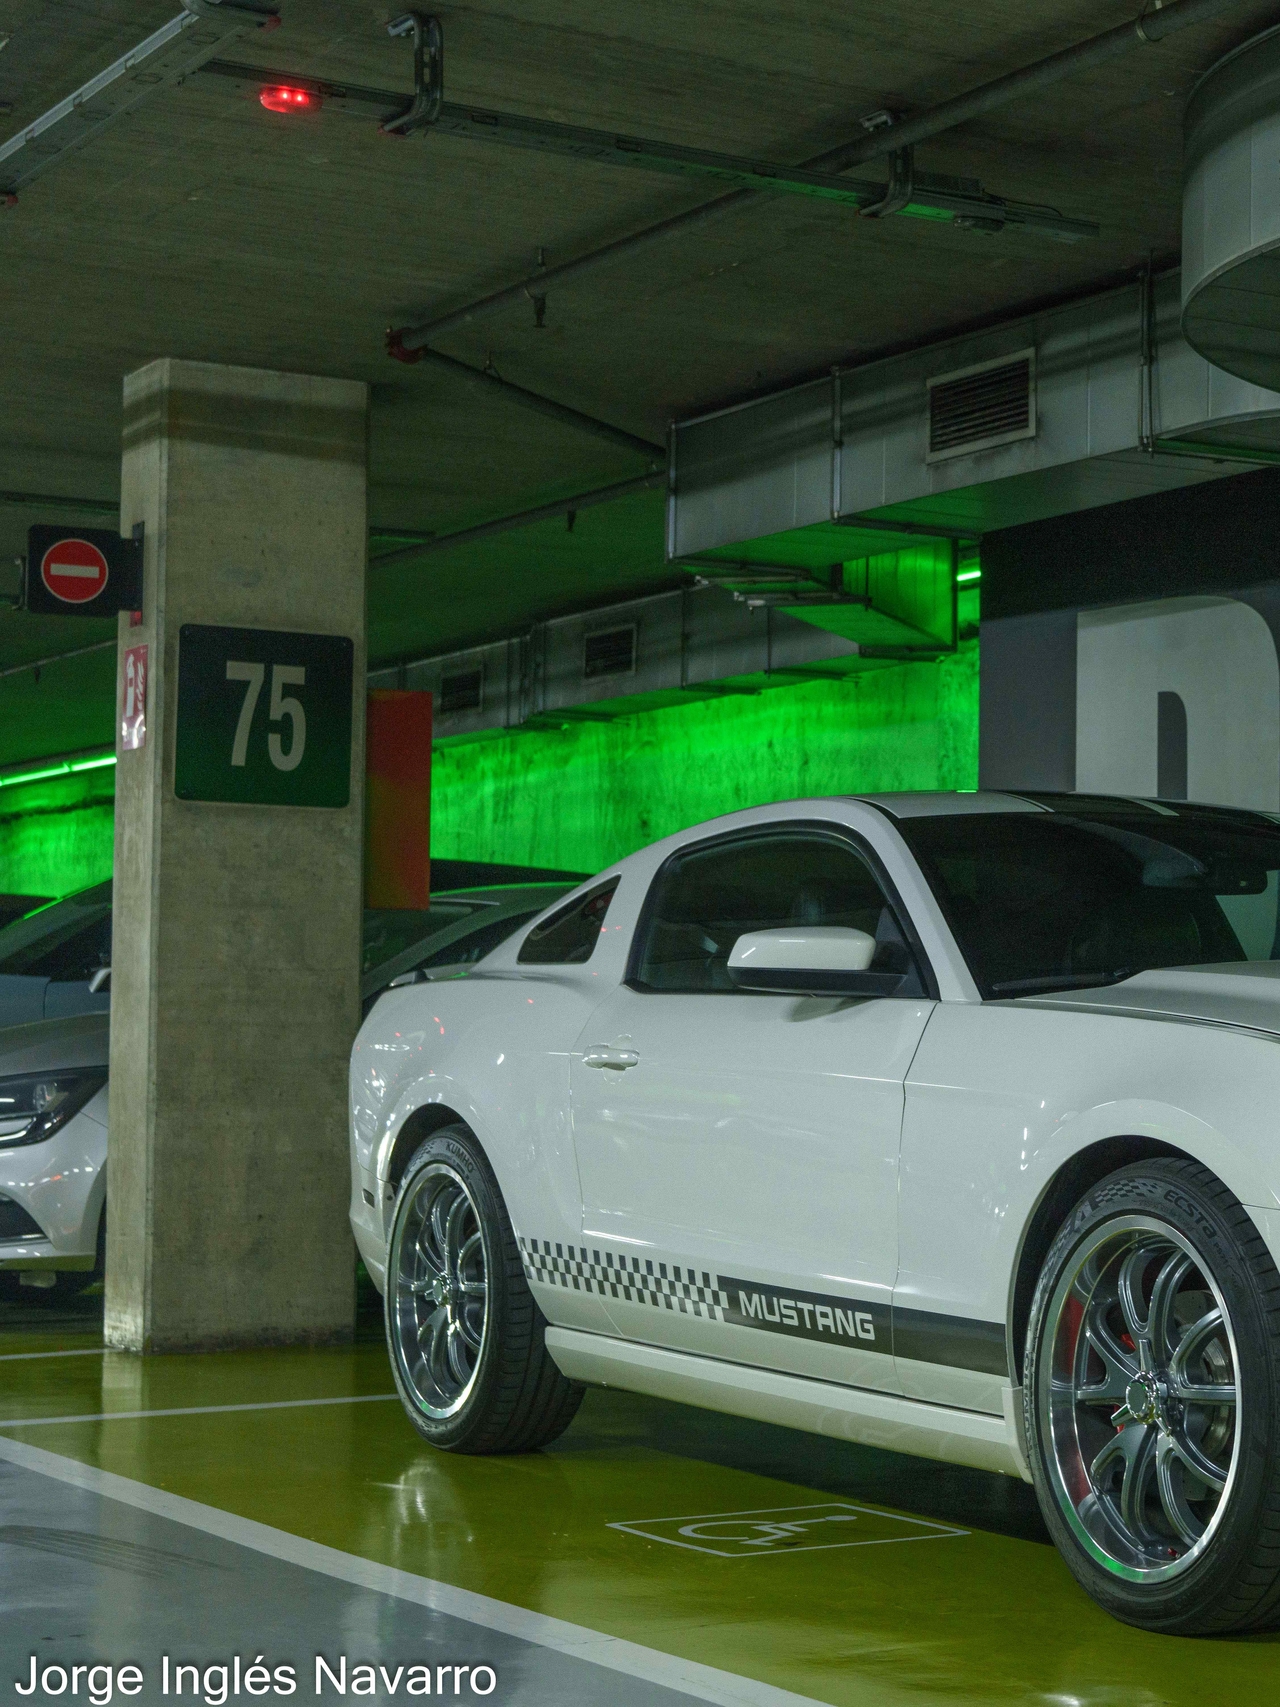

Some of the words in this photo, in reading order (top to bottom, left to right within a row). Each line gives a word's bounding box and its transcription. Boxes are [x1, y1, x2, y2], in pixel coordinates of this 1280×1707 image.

[226, 660, 306, 772] 75
[446, 1142, 476, 1174] KUMHO
[738, 1290, 876, 1341] MUSTANG
